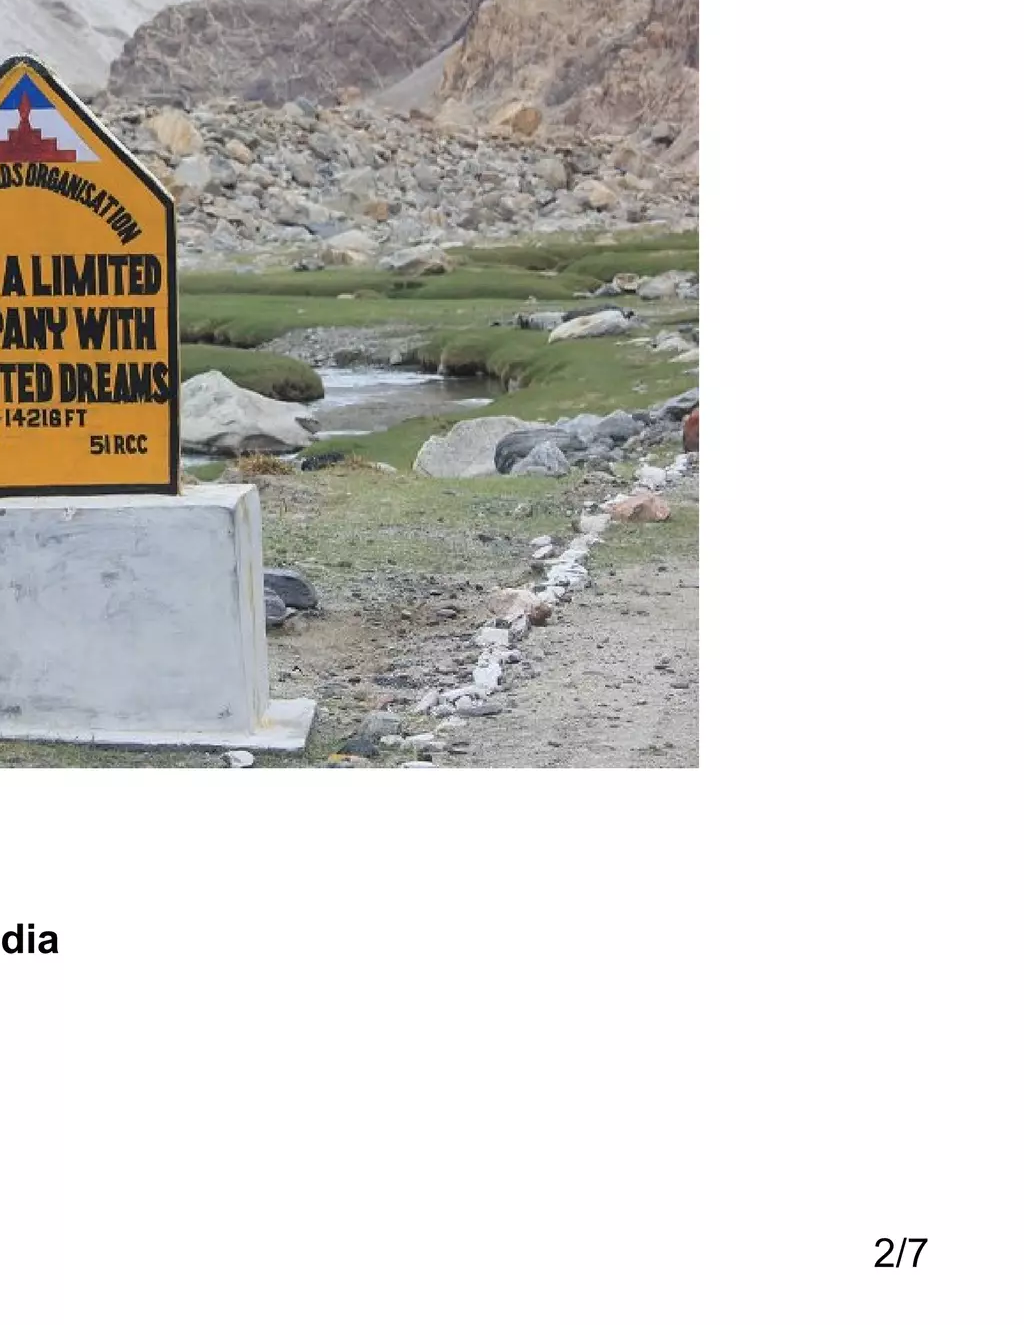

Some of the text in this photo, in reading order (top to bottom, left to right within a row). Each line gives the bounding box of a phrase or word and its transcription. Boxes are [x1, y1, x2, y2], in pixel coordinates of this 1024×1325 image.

[25, 163, 142, 245] ORGANISATION
[0, 255, 27, 297] A
[32, 254, 162, 297] LIMITED
[73, 307, 157, 350] WITH
[58, 361, 171, 404] DREAMS
[114, 434, 148, 455] RCC
[874, 1237, 929, 1269] 2/7
